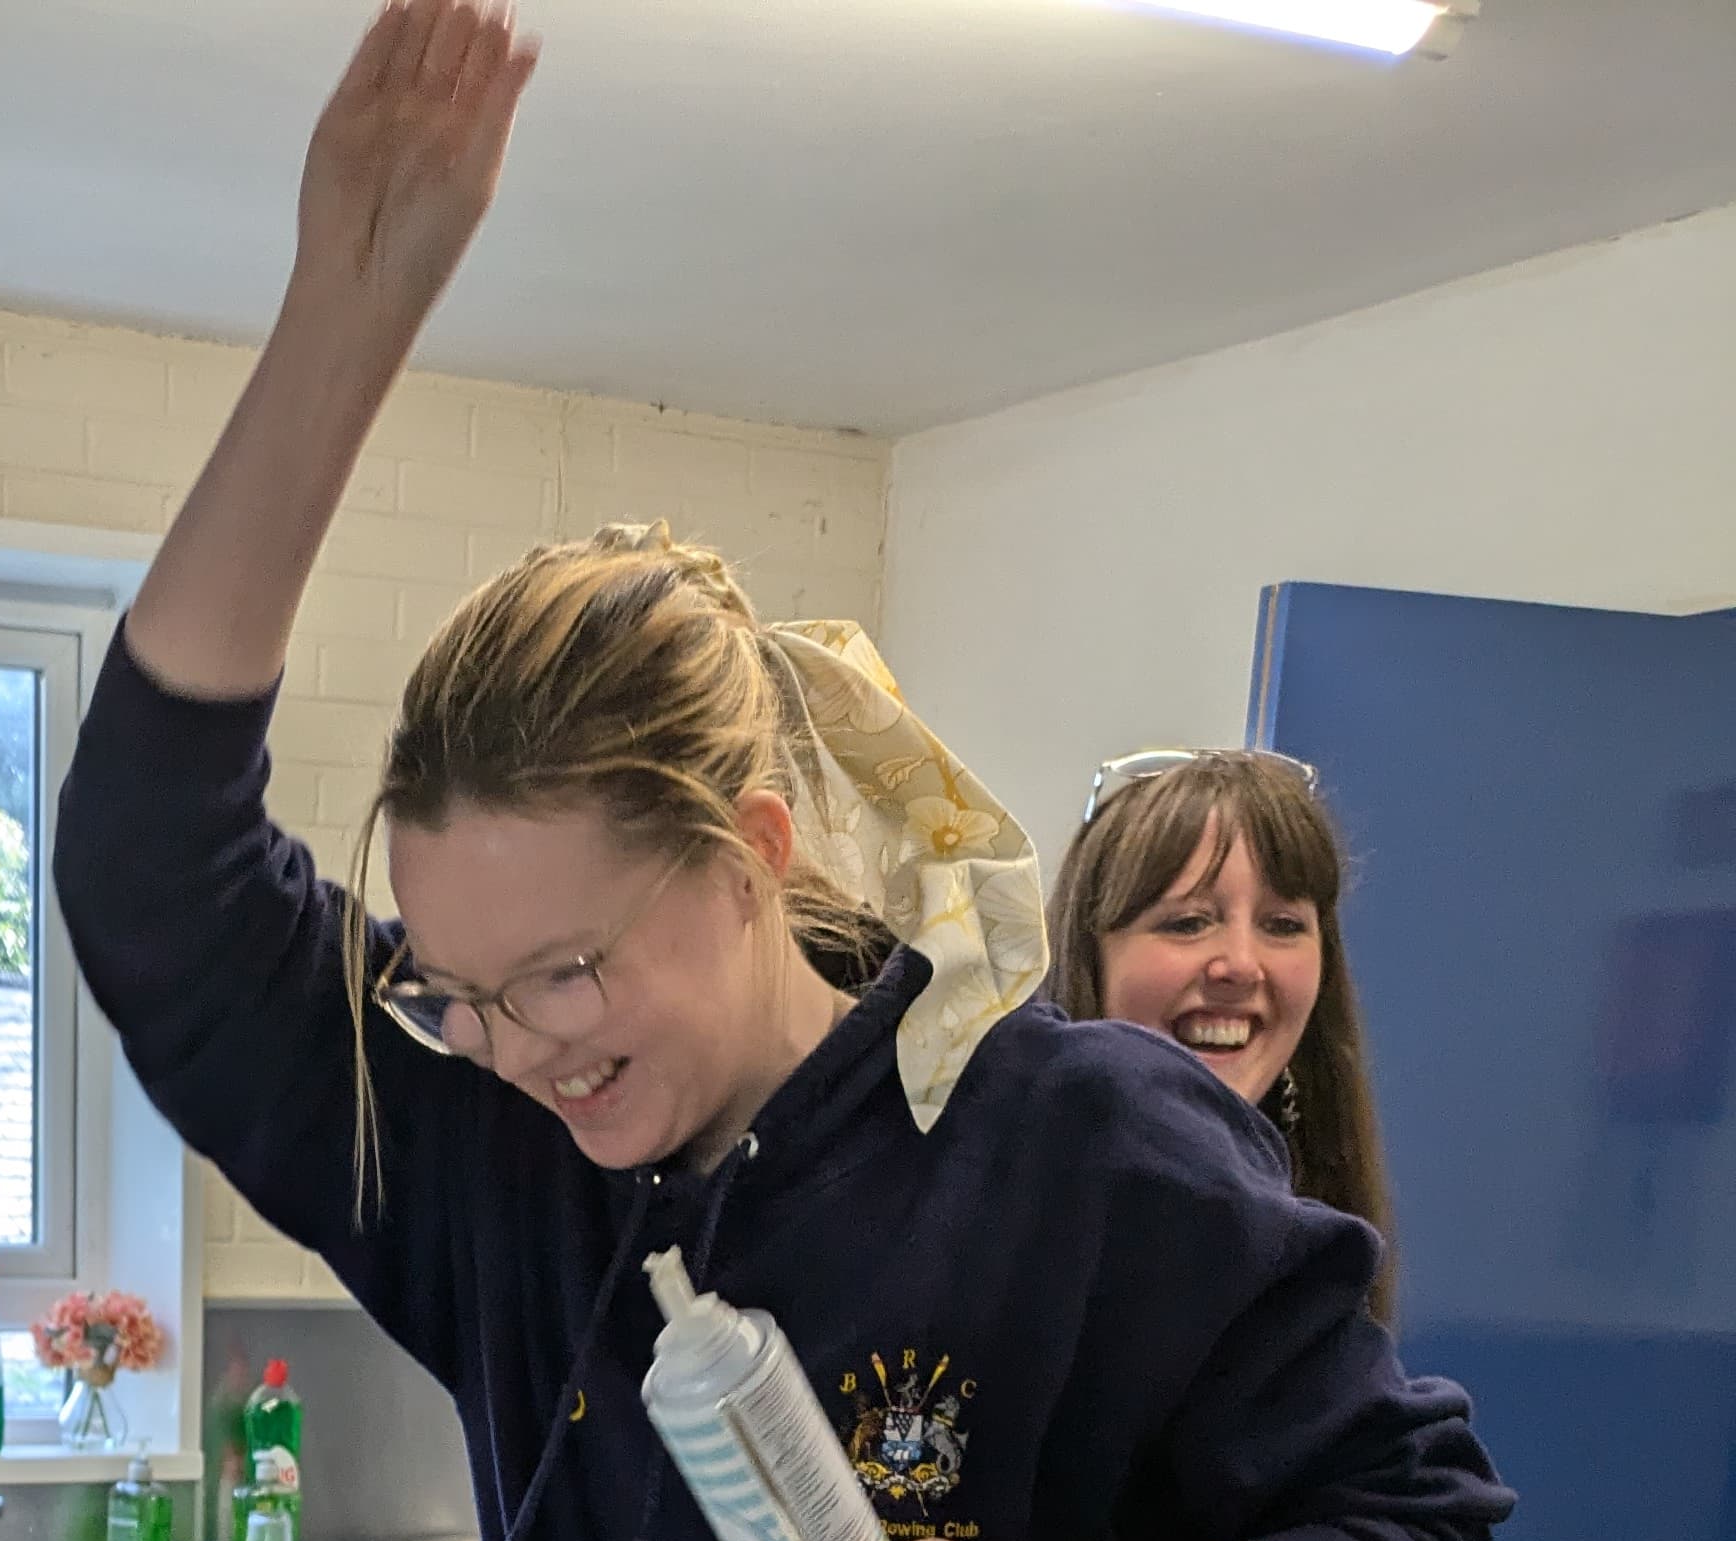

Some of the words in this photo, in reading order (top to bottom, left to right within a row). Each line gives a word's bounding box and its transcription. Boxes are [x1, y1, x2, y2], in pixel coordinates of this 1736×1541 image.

[839, 1372, 857, 1393] B
[902, 1348, 918, 1369] R
[960, 1379, 977, 1399] C
[944, 1520, 979, 1537] Club
